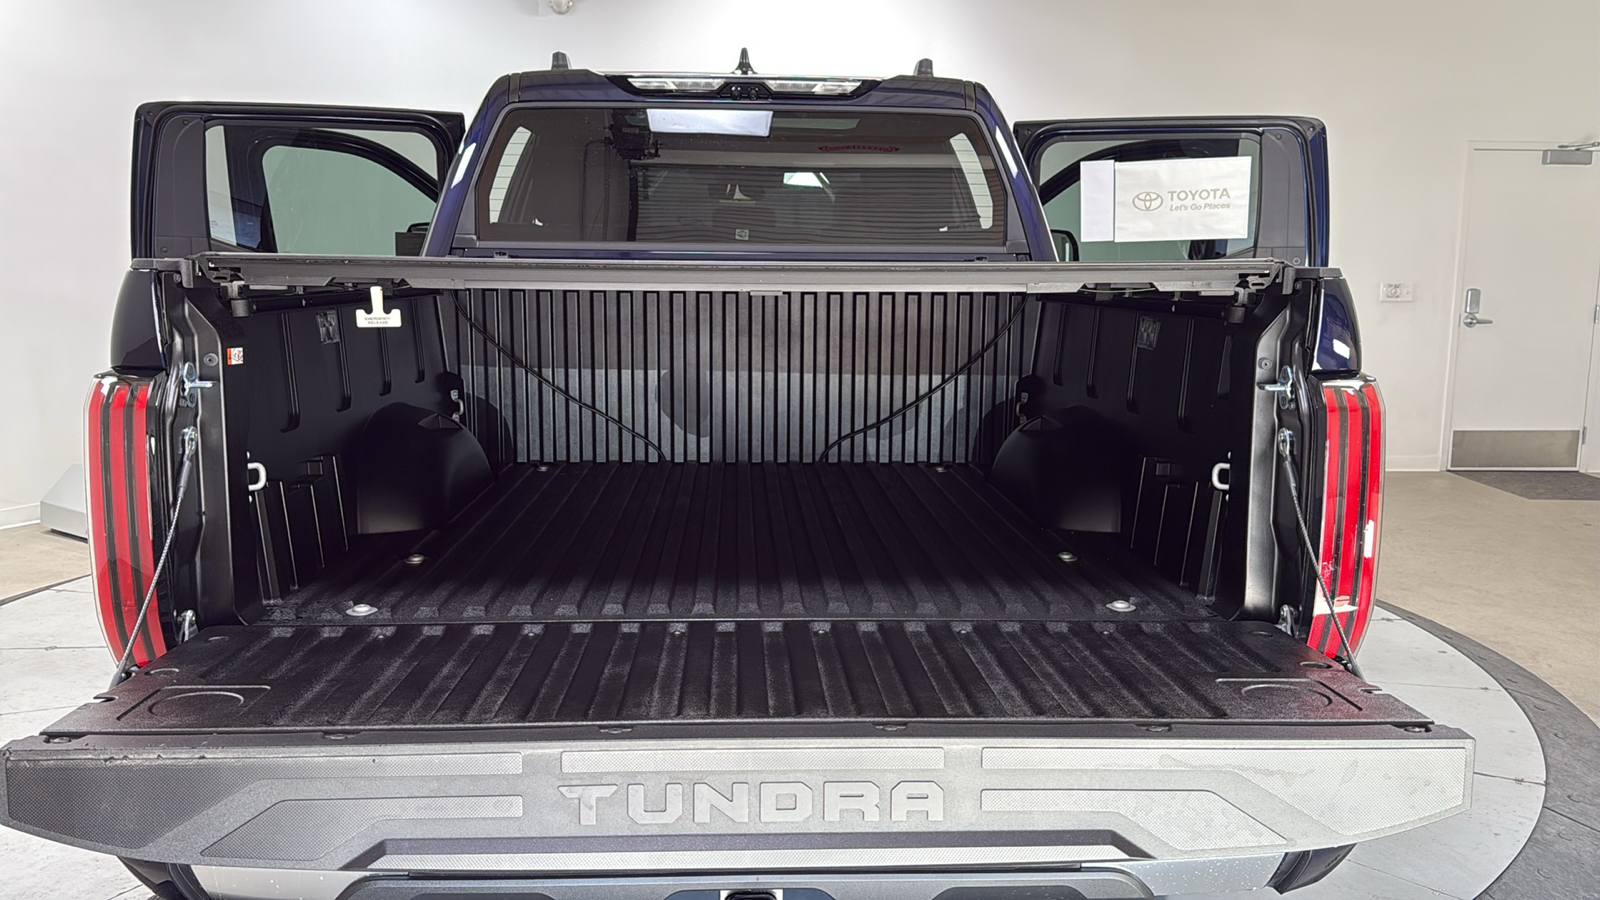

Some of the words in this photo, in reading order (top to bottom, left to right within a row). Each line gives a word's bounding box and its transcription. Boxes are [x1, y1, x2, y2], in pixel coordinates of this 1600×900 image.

[1167, 188, 1231, 201] TOYOTA
[1169, 204, 1189, 212] Let's
[1190, 203, 1203, 211] Go
[1203, 202, 1231, 210] Places
[557, 780, 944, 825] TUNDRA
